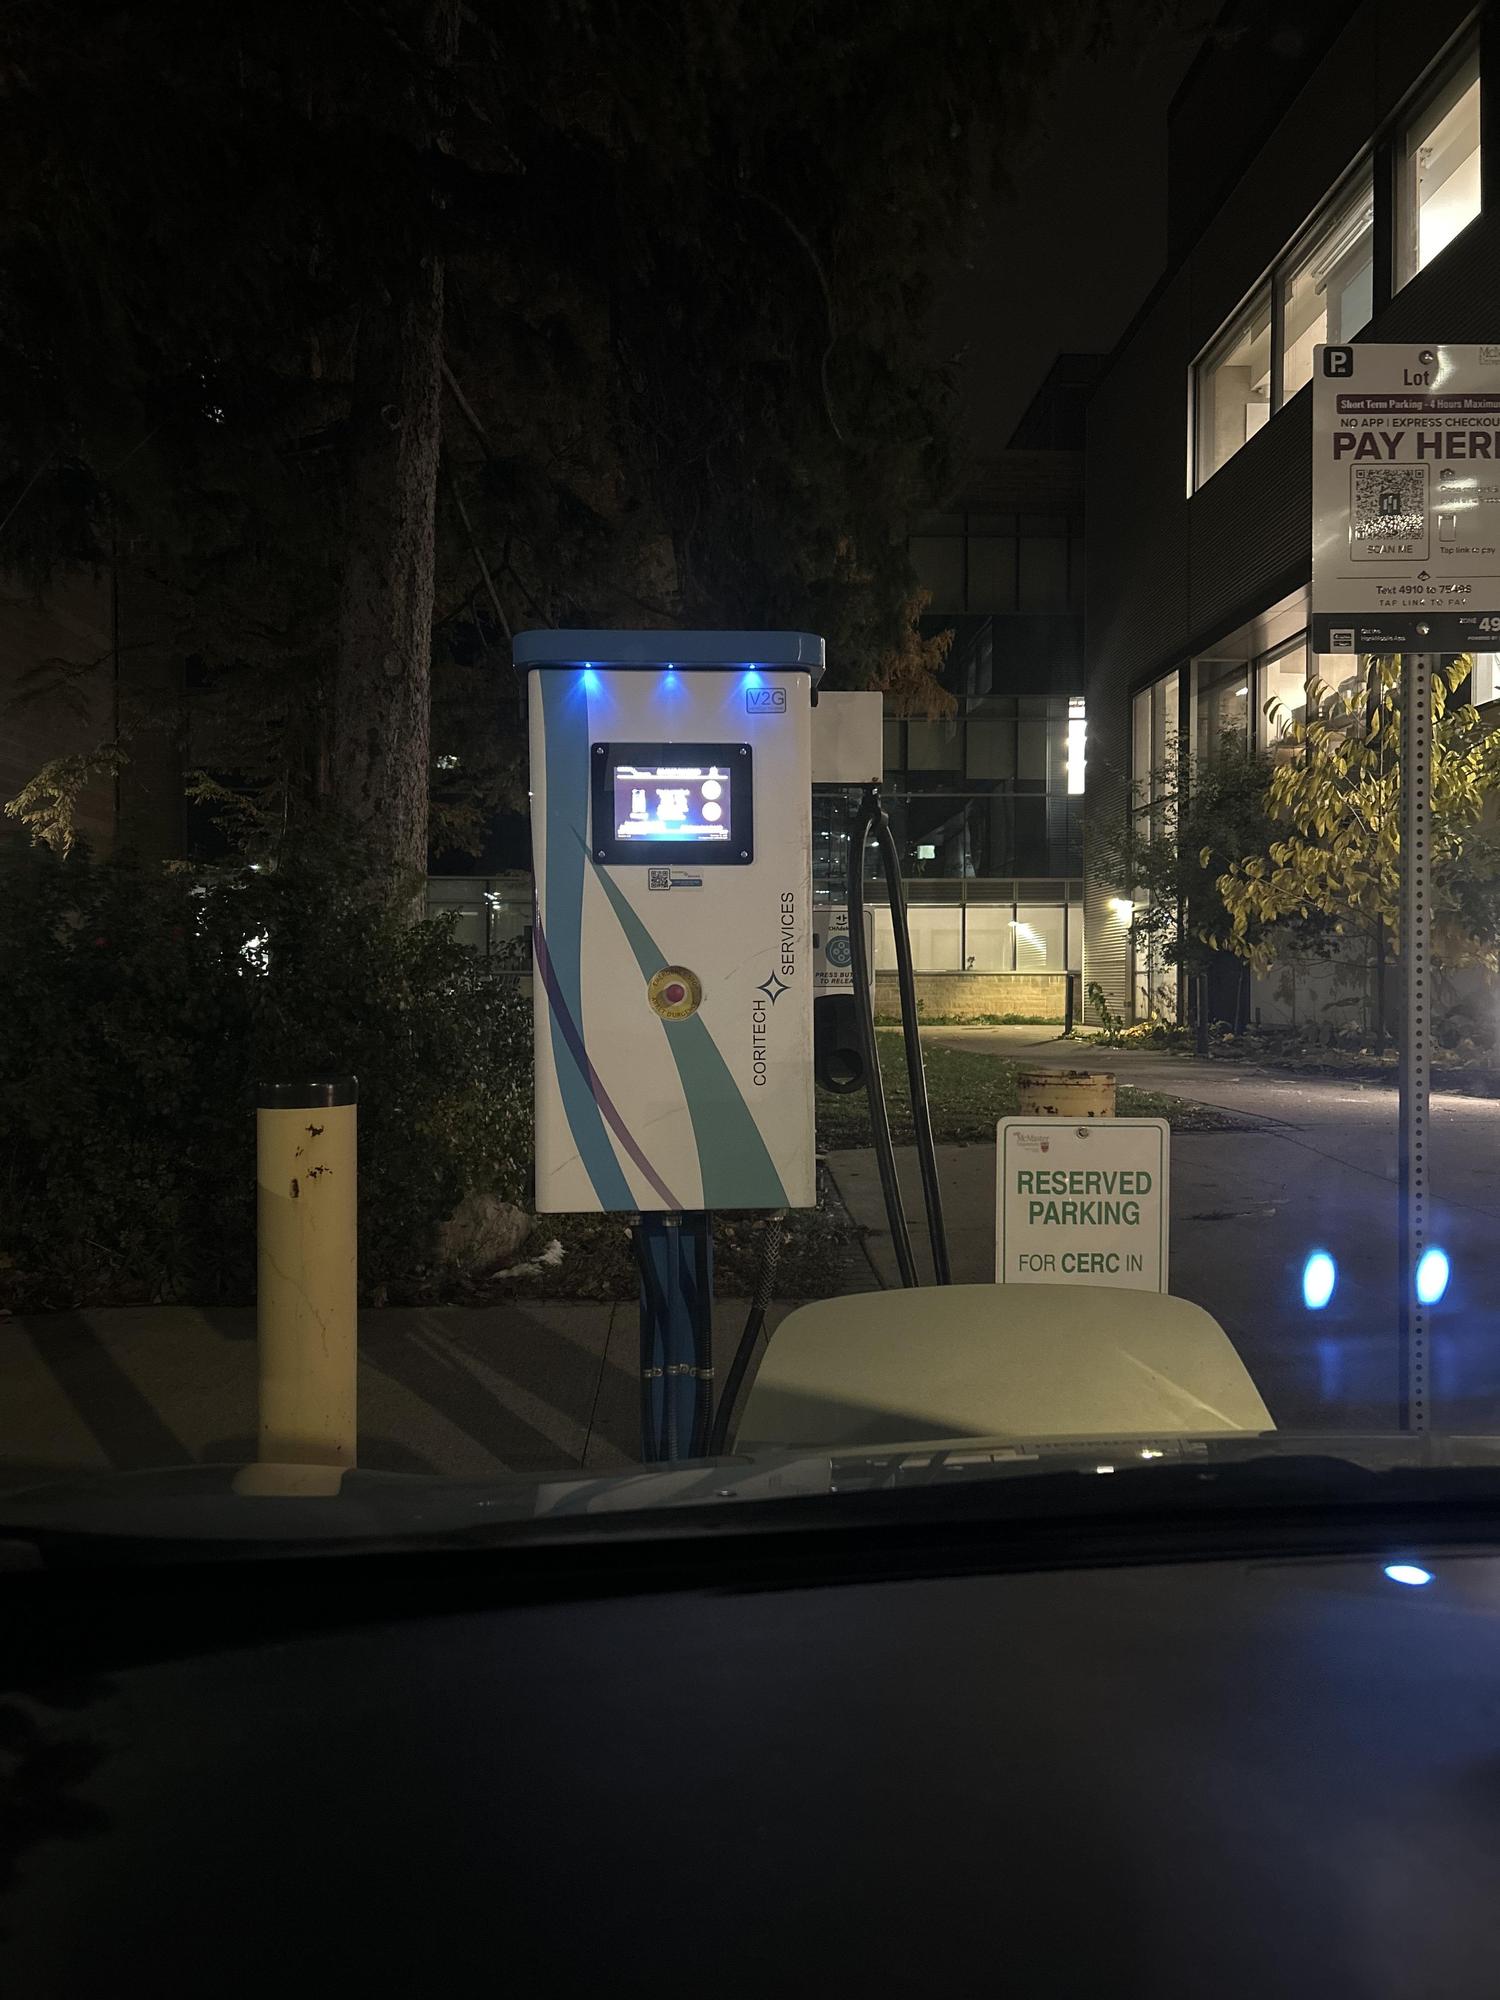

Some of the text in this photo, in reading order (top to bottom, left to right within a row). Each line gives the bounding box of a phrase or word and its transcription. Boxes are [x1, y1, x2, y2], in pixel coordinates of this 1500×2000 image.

[1331, 351, 1347, 373] P
[1404, 368, 1430, 386] Lot
[1341, 399, 1366, 409] Short
[1366, 399, 1388, 409] Term
[1388, 399, 1422, 410] Parking
[1437, 399, 1461, 409] Hours
[1463, 398, 1500, 408] Maximu
[1340, 418, 1358, 428] NO
[1361, 418, 1384, 428] APP
[1392, 418, 1442, 428] EXPRESS
[1444, 417, 1500, 427] CHECKOU
[1334, 432, 1405, 460] PAY
[1367, 544, 1396, 554] SCAN
[1376, 586, 1396, 594] Text
[1399, 585, 1424, 594] 4910
[1426, 586, 1436, 594] to
[1479, 617, 1500, 632] 49
[749, 691, 784, 706] V2G
[781, 892, 794, 976] SERVICES
[753, 1000, 766, 1086] CORITECH
[1018, 1170, 1152, 1195] RESERVED
[1030, 1200, 1140, 1225] PARKING
[1020, 1252, 1142, 1273] FOR CERC IN
